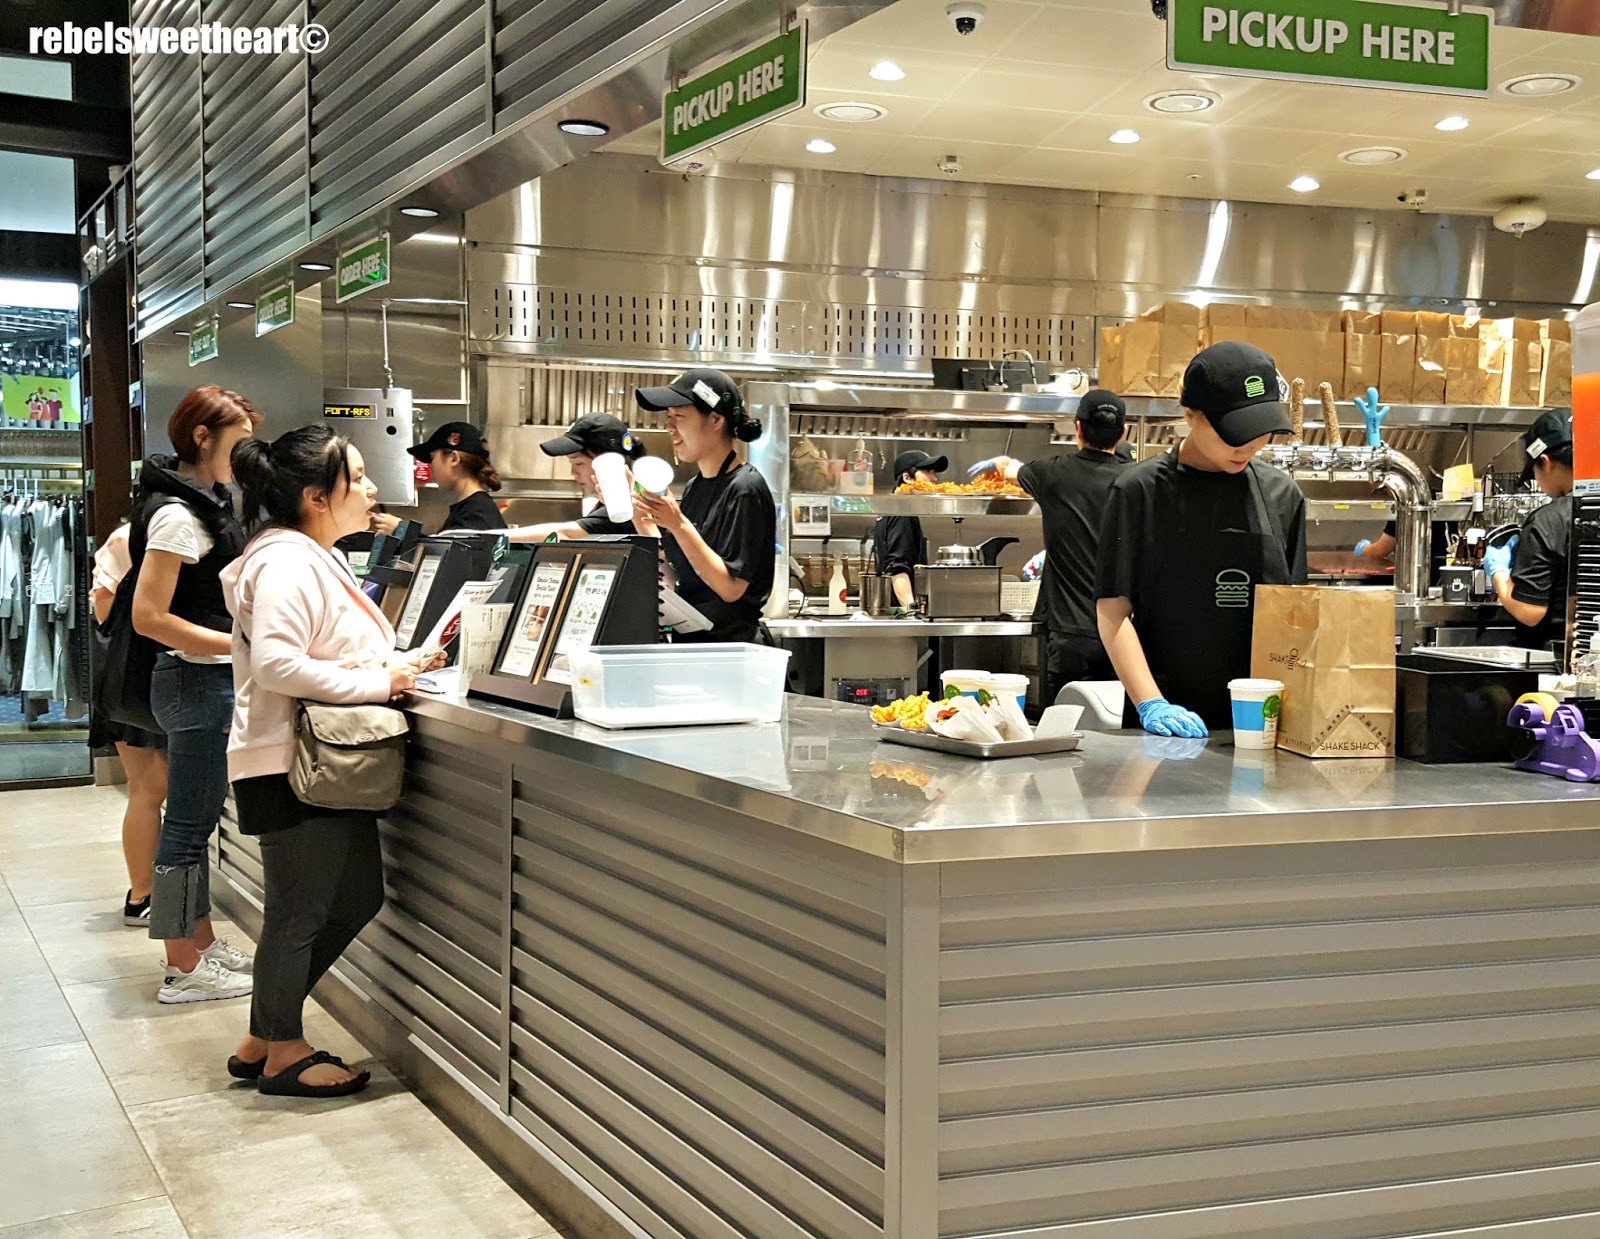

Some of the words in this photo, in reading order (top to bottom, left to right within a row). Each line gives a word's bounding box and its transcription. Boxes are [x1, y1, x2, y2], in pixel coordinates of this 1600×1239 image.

[1202, 7, 1348, 54] PICKUP
[1362, 24, 1455, 65] HERE
[673, 81, 734, 135] PICKUP
[738, 55, 784, 105] HERE
[362, 252, 381, 277] HERE
[1320, 742, 1349, 751] SHAKE
[1350, 742, 1381, 751] SHACK
